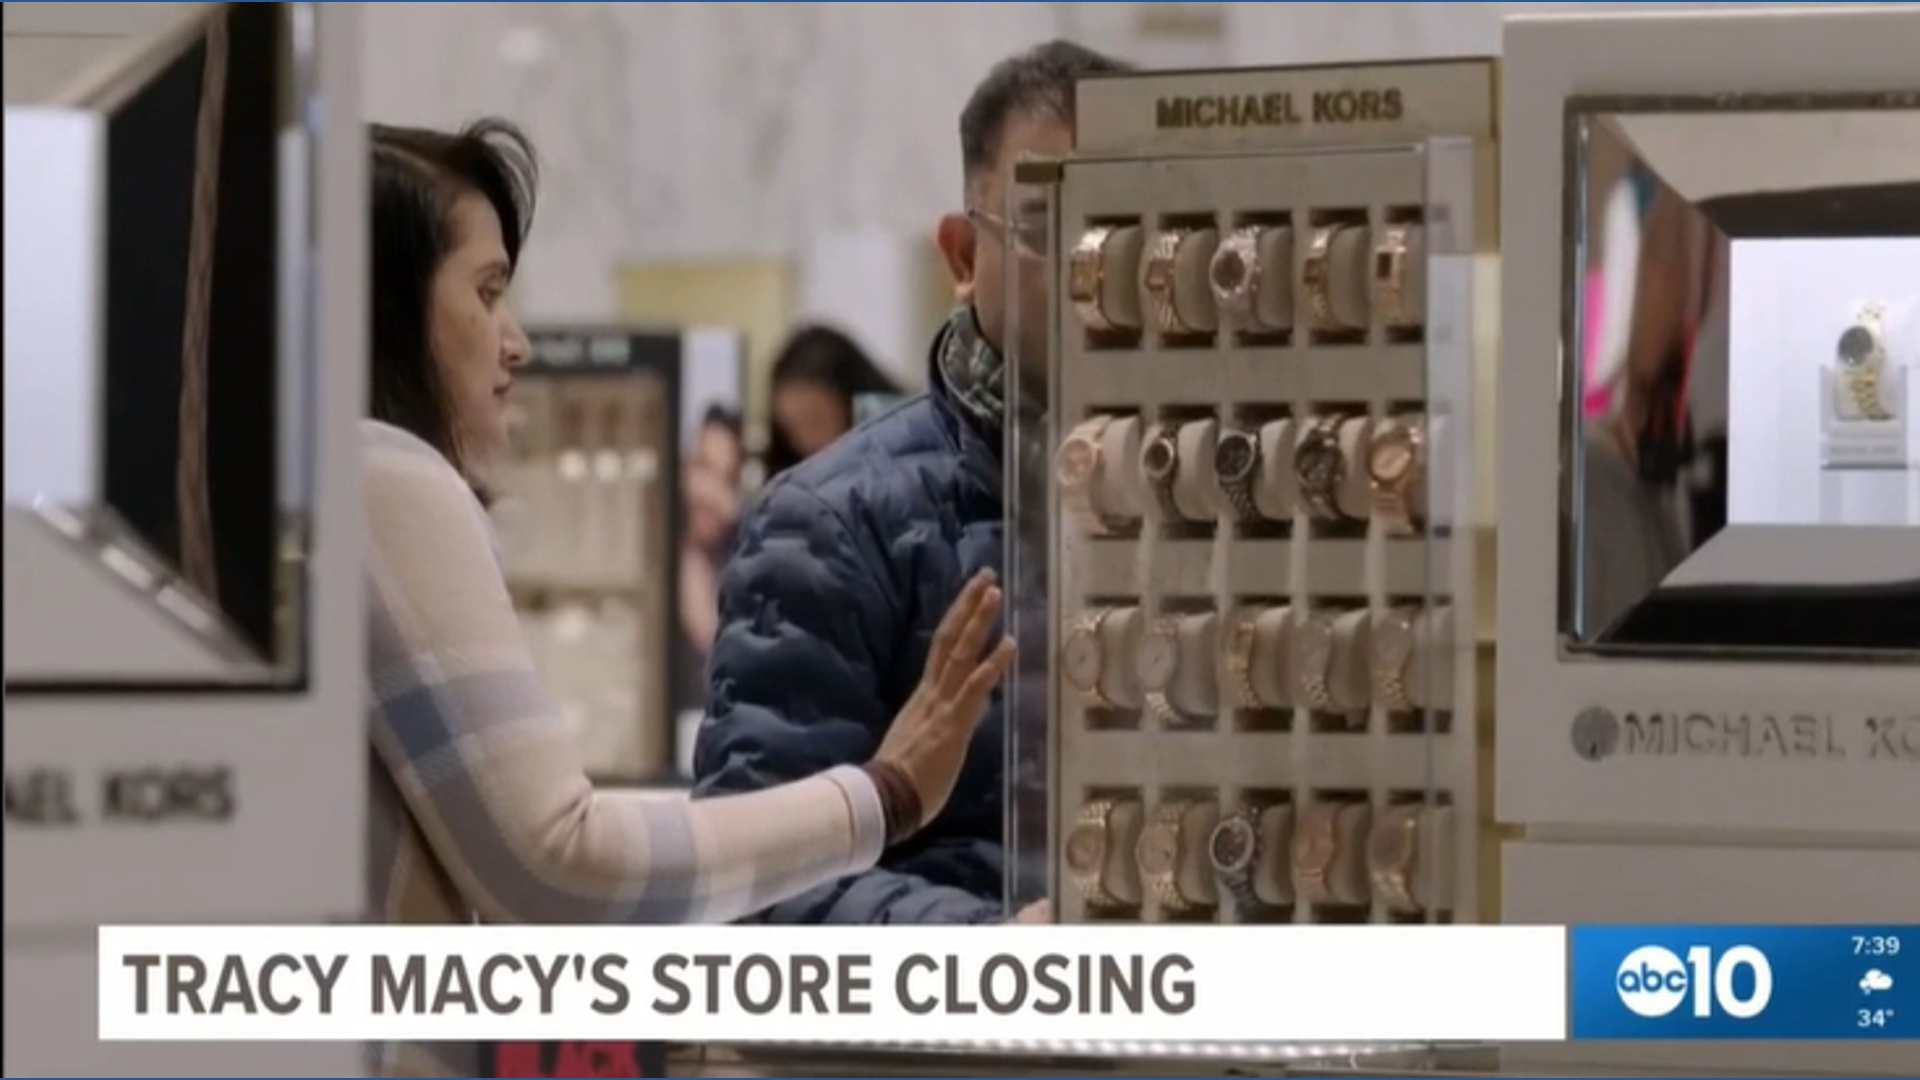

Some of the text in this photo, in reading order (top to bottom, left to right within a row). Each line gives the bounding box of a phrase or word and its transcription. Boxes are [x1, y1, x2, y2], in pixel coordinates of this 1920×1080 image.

[1156, 88, 1402, 127] MICHAEL KORS
[1624, 712, 1847, 758] MICHAEL
[102, 765, 237, 824] KORS
